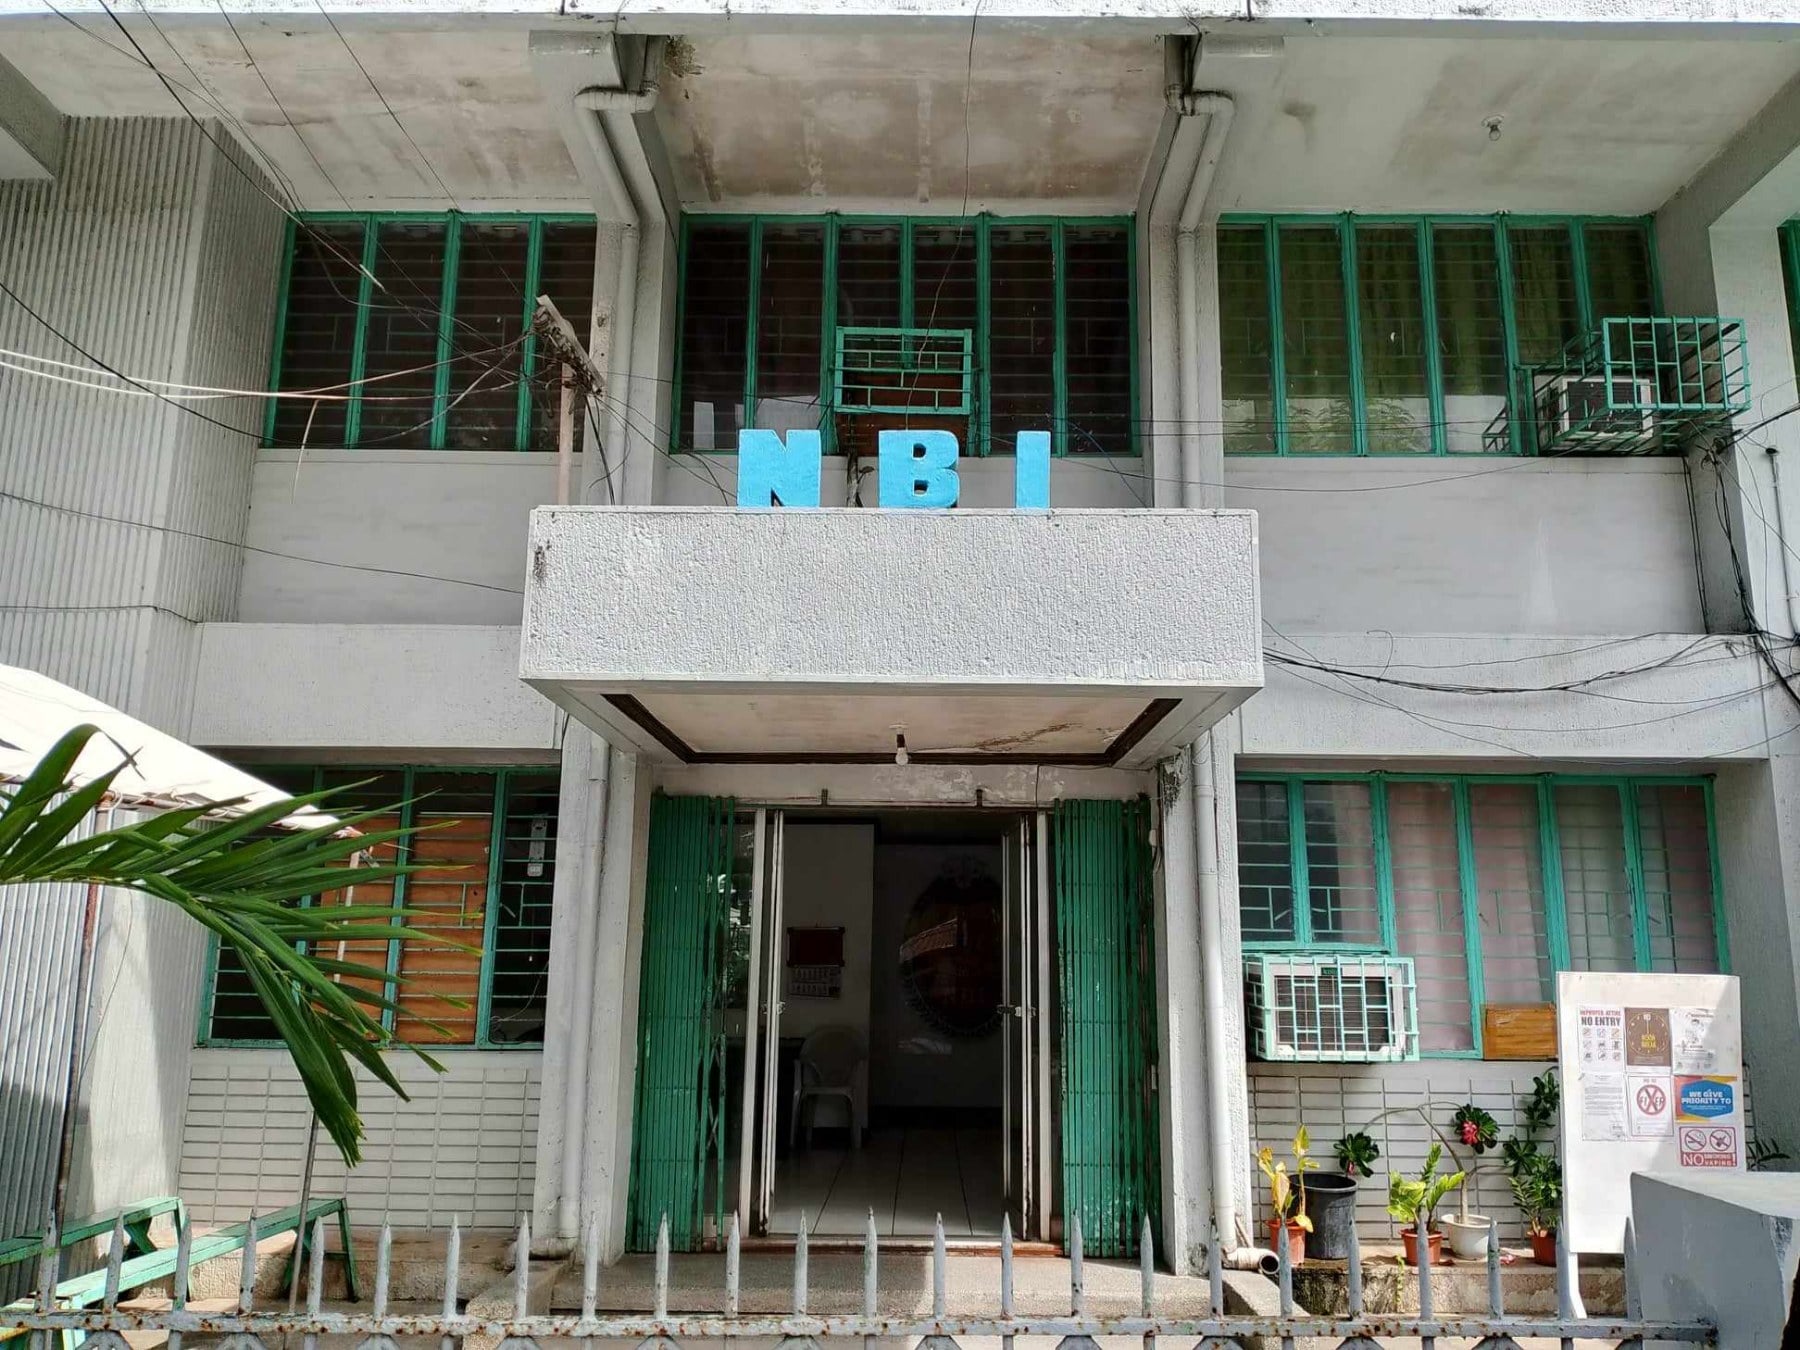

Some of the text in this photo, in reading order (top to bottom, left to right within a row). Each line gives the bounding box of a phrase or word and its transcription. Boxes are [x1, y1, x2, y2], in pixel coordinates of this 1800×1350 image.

[737, 429, 1051, 509] NBI
[1581, 1016, 1621, 1027] NO ENTRY
[1703, 1090, 1723, 1098] GIVE
[1683, 1153, 1704, 1166] NO
